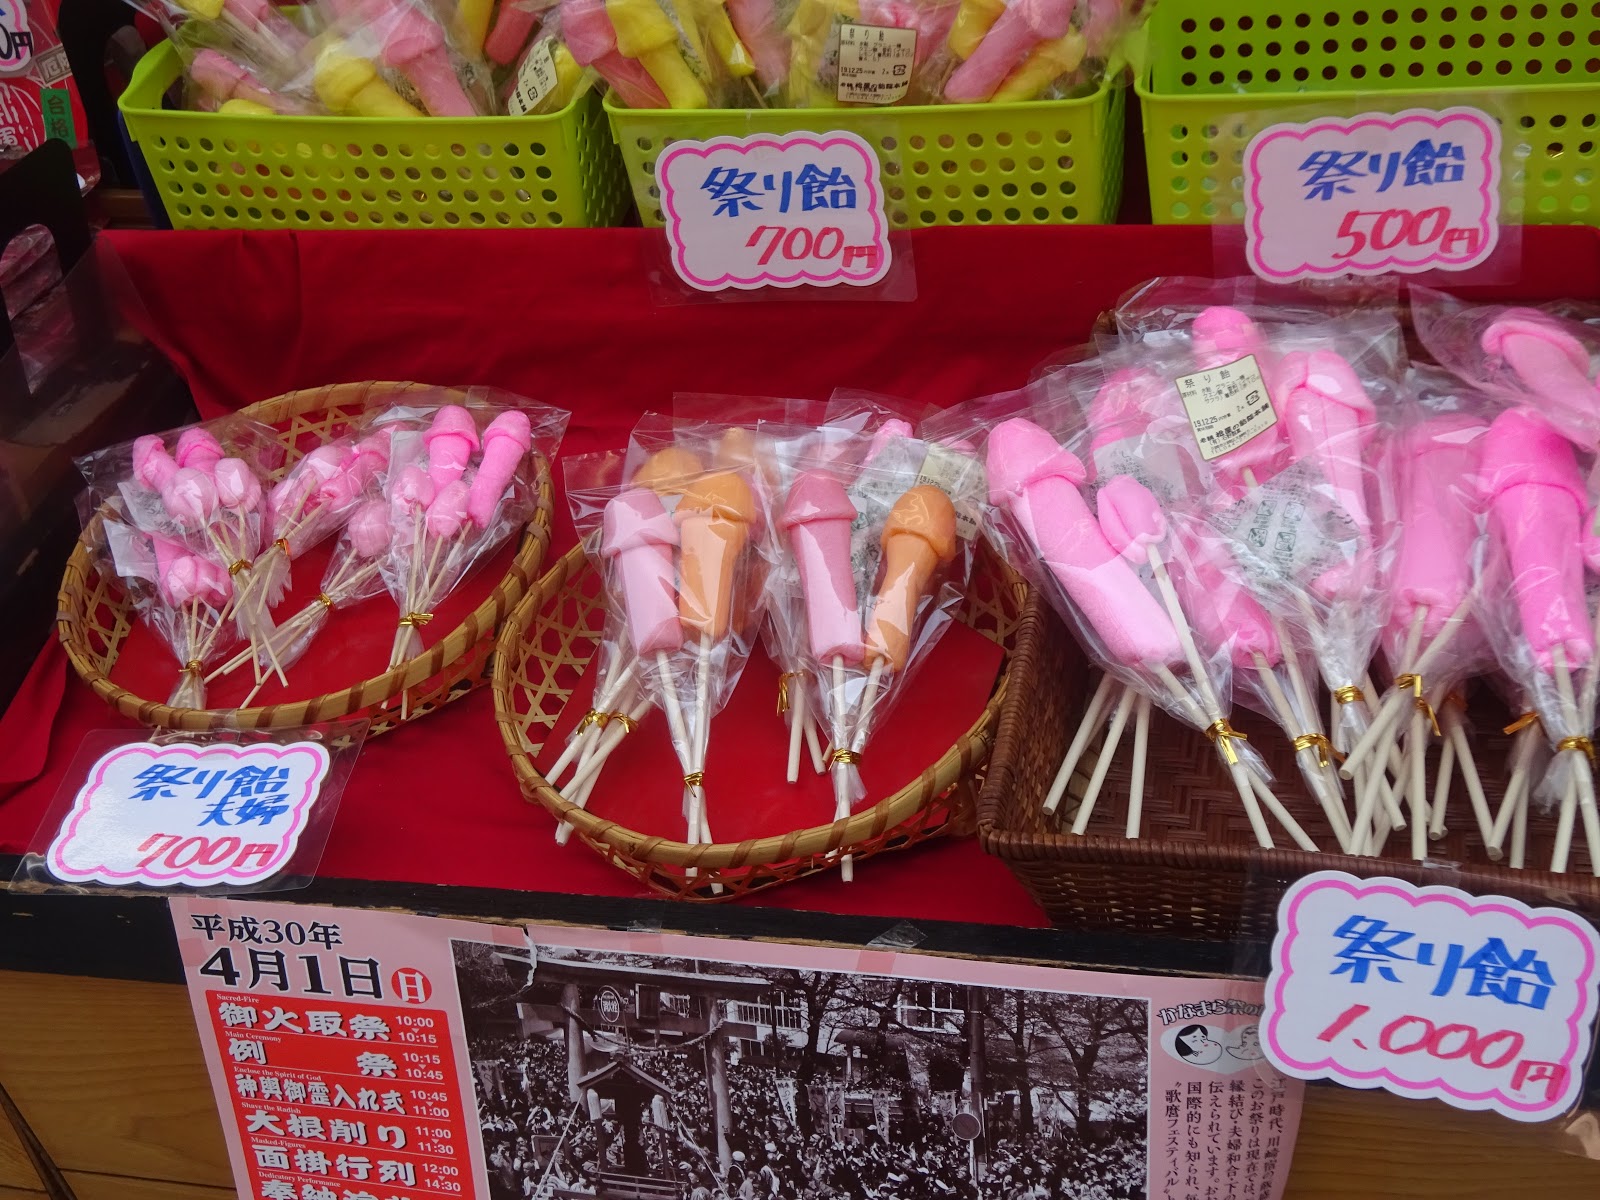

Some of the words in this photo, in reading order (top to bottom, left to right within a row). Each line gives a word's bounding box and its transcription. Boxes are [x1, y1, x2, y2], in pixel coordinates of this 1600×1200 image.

[1298, 139, 1467, 201] 祭り飴
[700, 164, 857, 217] 祭り飴
[1331, 206, 1480, 259] 500円
[745, 225, 879, 269] 700円
[128, 764, 290, 801] 祭り飴
[197, 793, 290, 827] 夫婦
[136, 833, 278, 867] 700円
[190, 913, 344, 951] 平成30年
[1330, 915, 1557, 1010] 祭り飴
[199, 946, 384, 1000] 4月1日
[398, 971, 427, 1003] 日
[216, 993, 260, 1004] Sacred-Fire
[218, 1001, 391, 1041] 御火取祭
[395, 1015, 435, 1028] 10:00
[225, 1030, 244, 1038] Main
[246, 1032, 282, 1043] Ceremony
[398, 1031, 438, 1044] 10:15
[402, 1052, 441, 1065] 10:15
[233, 1066, 261, 1075] Enclose
[262, 1069, 273, 1077] the
[274, 1070, 296, 1080] Spirit
[297, 1072, 305, 1080] of
[306, 1073, 323, 1082] God
[406, 1068, 444, 1081] 10:45
[235, 1073, 406, 1115] 神輿御霊入れ式
[410, 1089, 448, 1102] 10:45
[241, 1102, 262, 1110] Shave
[276, 1105, 302, 1115] Radish
[413, 1105, 450, 1118] 11:00
[245, 1109, 406, 1149] 大根削り
[415, 1126, 452, 1139] 11:00
[250, 1136, 307, 1149] Masked-Figures
[418, 1141, 455, 1155] 11:30
[251, 1144, 417, 1187] 面掛行列
[422, 1163, 459, 1176] 12:00
[258, 1171, 296, 1183] Dedicatory
[296, 1175, 342, 1188] Performance
[424, 1178, 461, 1192] 14:30
